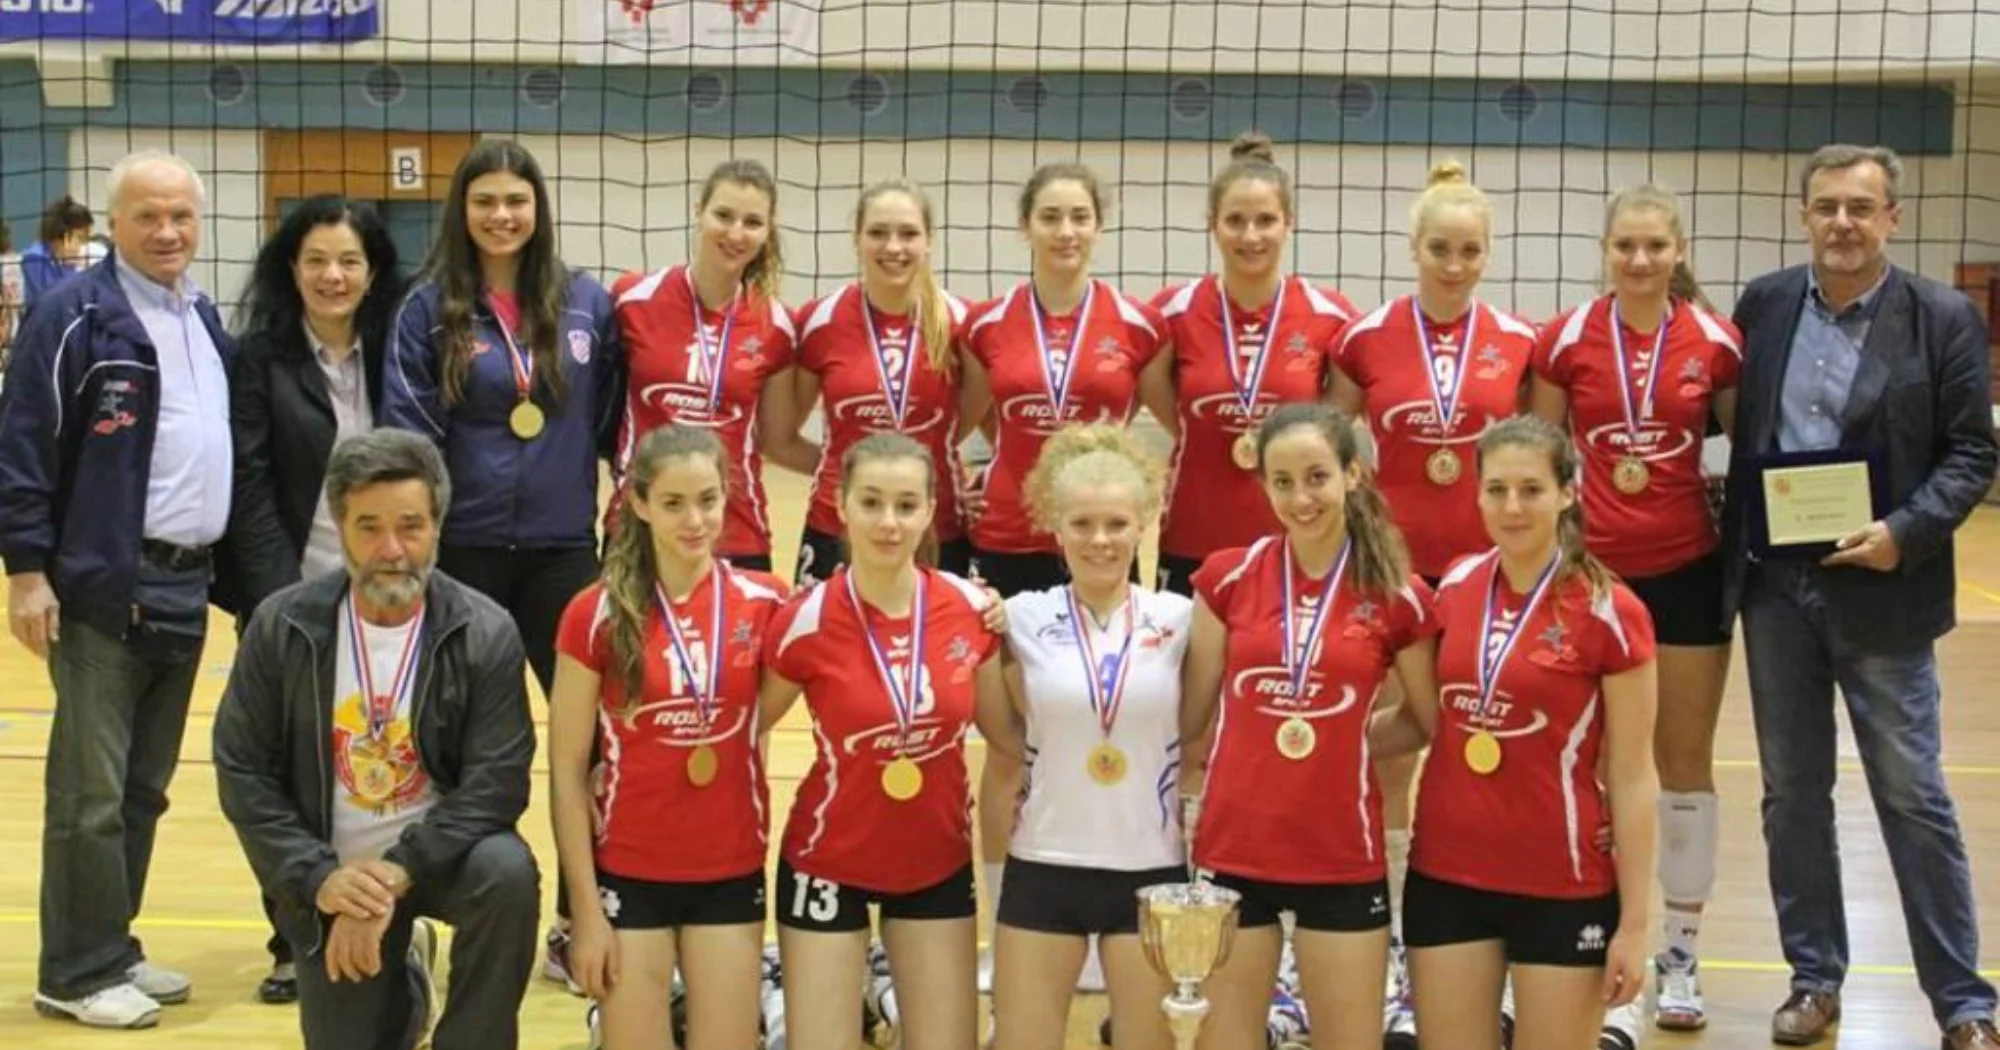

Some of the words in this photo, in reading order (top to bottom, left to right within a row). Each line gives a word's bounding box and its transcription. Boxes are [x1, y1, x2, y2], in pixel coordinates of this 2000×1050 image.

[399, 155, 417, 185] B
[1434, 355, 1456, 396] 9
[1020, 403, 1083, 418] ROT
[1405, 412, 1467, 426] ROT
[792, 871, 840, 921] 13
